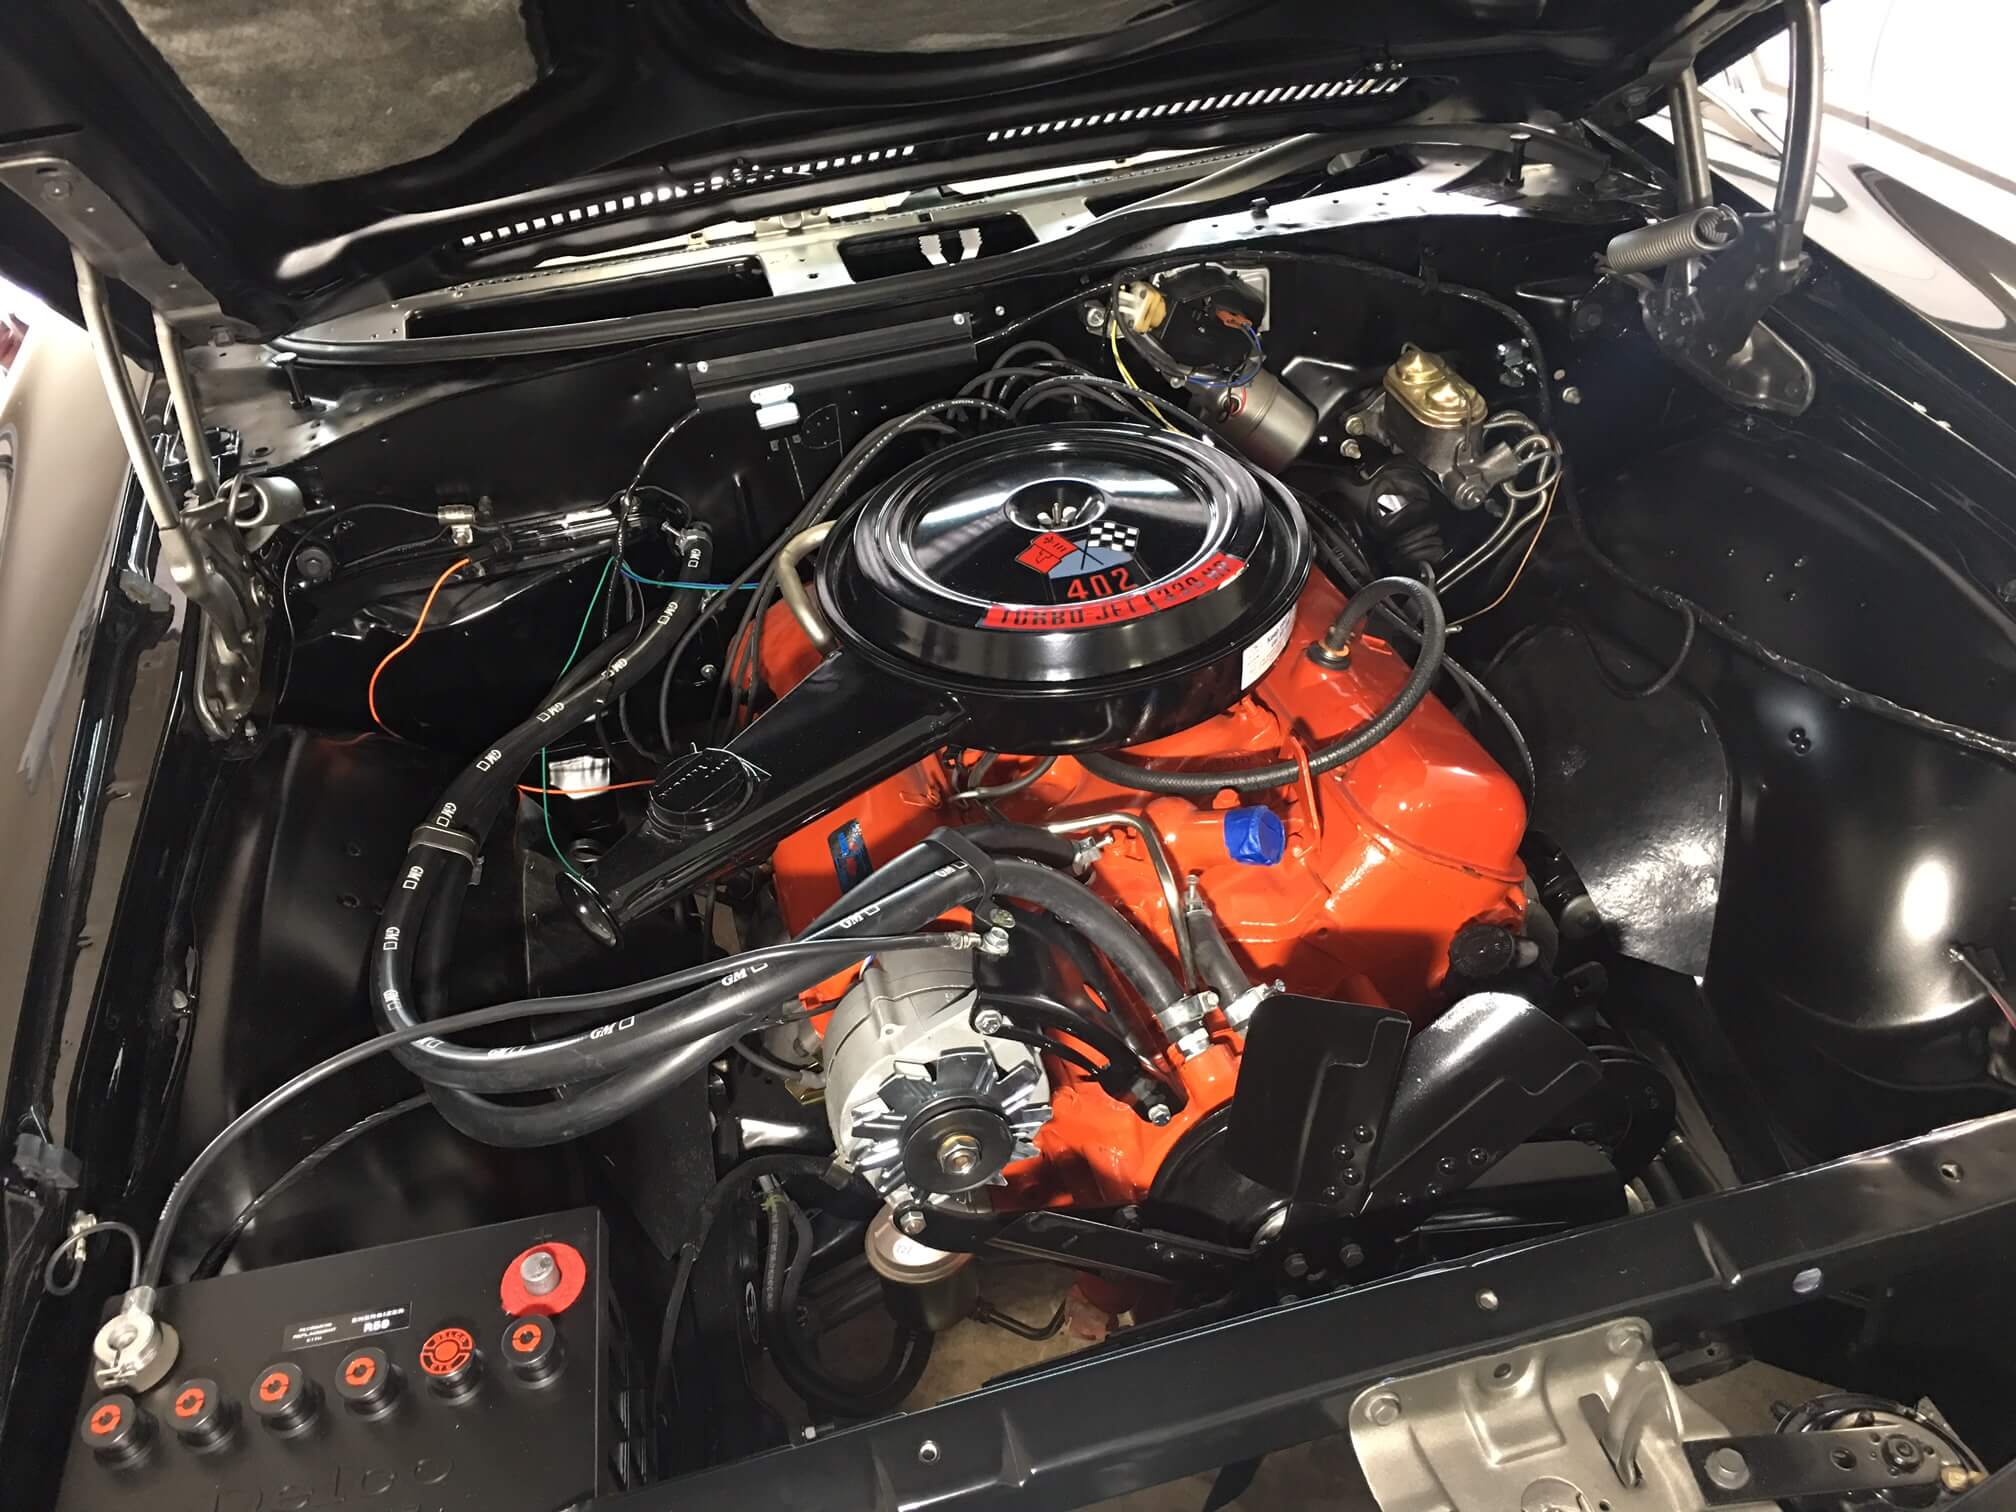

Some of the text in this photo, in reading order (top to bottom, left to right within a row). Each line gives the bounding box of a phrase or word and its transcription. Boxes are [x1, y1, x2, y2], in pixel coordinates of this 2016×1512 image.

[1067, 567, 1139, 599] 402
[721, 968, 748, 986] GM
[590, 1022, 616, 1040] GM
